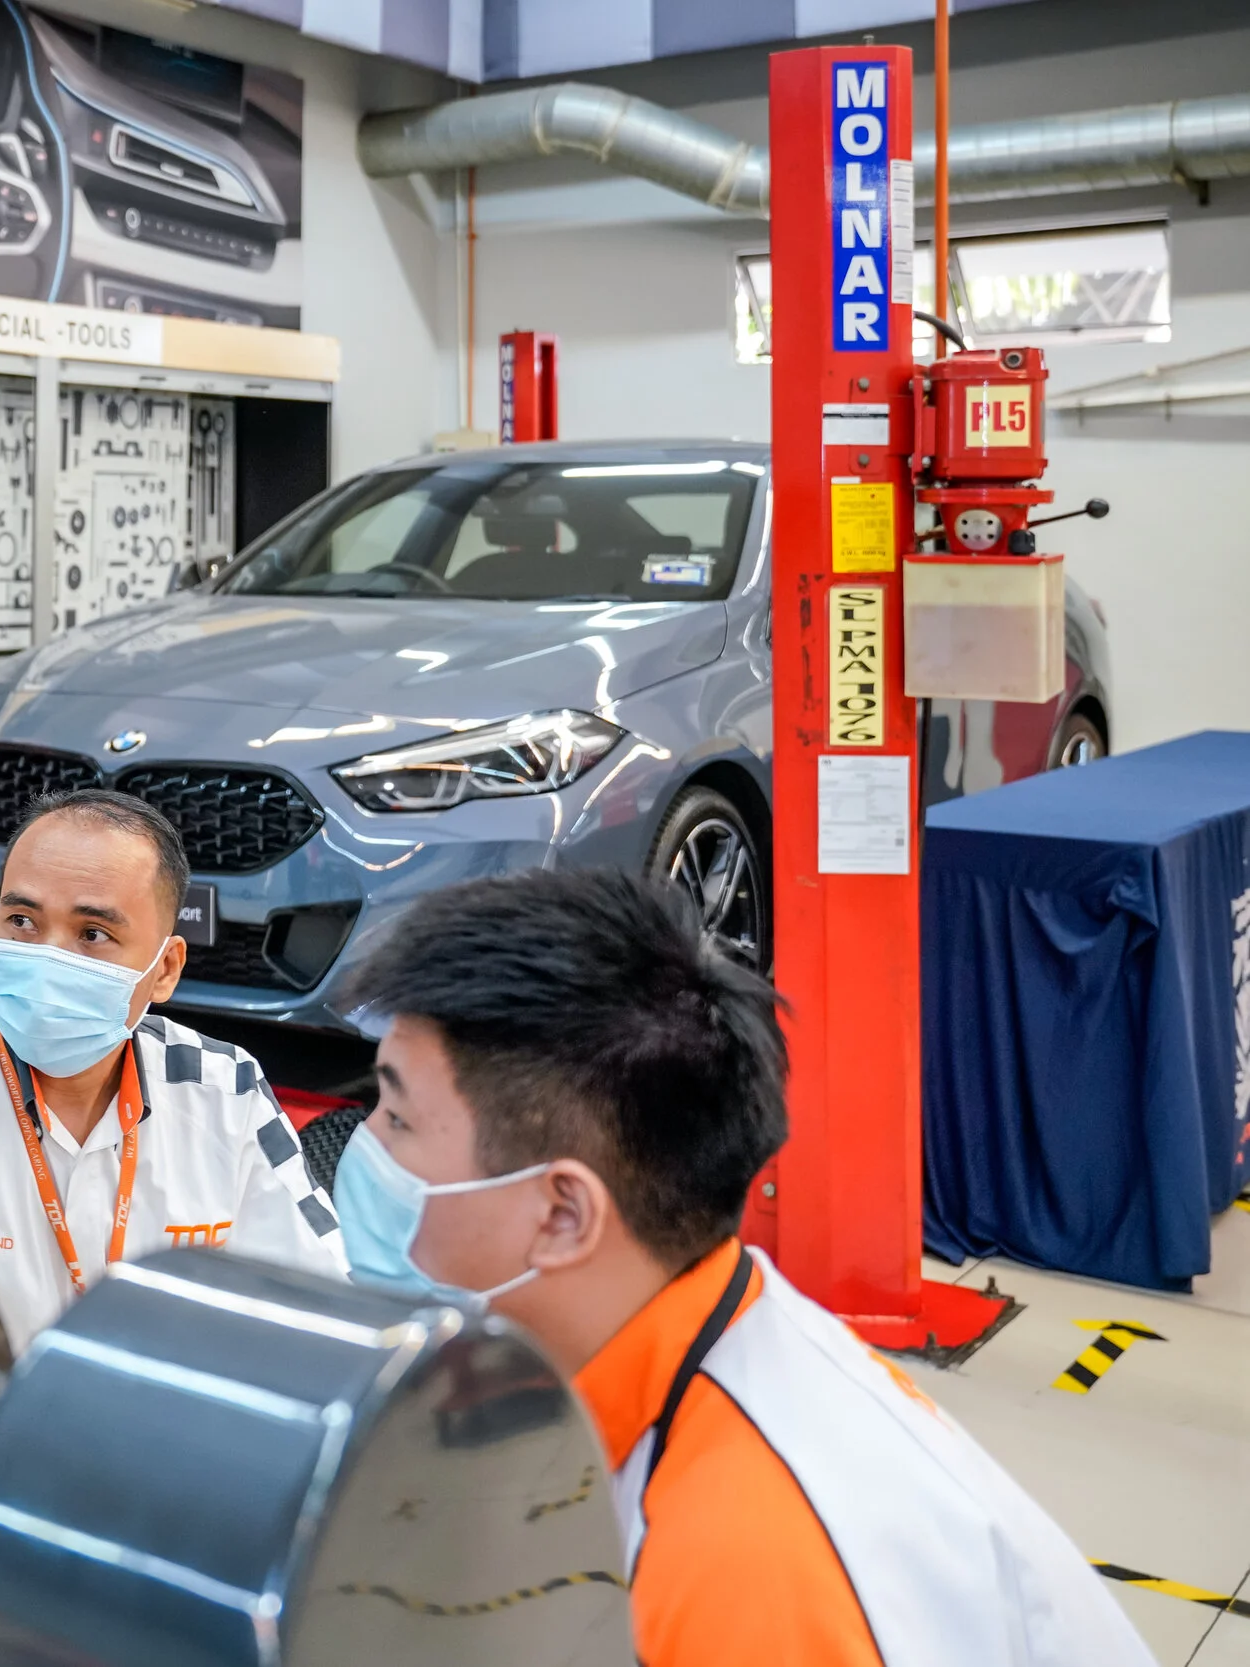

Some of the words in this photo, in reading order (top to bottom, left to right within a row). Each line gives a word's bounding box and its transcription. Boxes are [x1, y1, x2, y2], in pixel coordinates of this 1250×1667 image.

[837, 68, 885, 342] MOLNAR
[501, 343, 515, 446] MOLNA
[971, 401, 1026, 432] PL5
[0, 1053, 24, 1110] TRUSTWORTHY
[20, 1118, 32, 1140] OPEN
[30, 1148, 47, 1180] CARING
[45, 1199, 67, 1232] TOC
[115, 1194, 130, 1228] TOC
